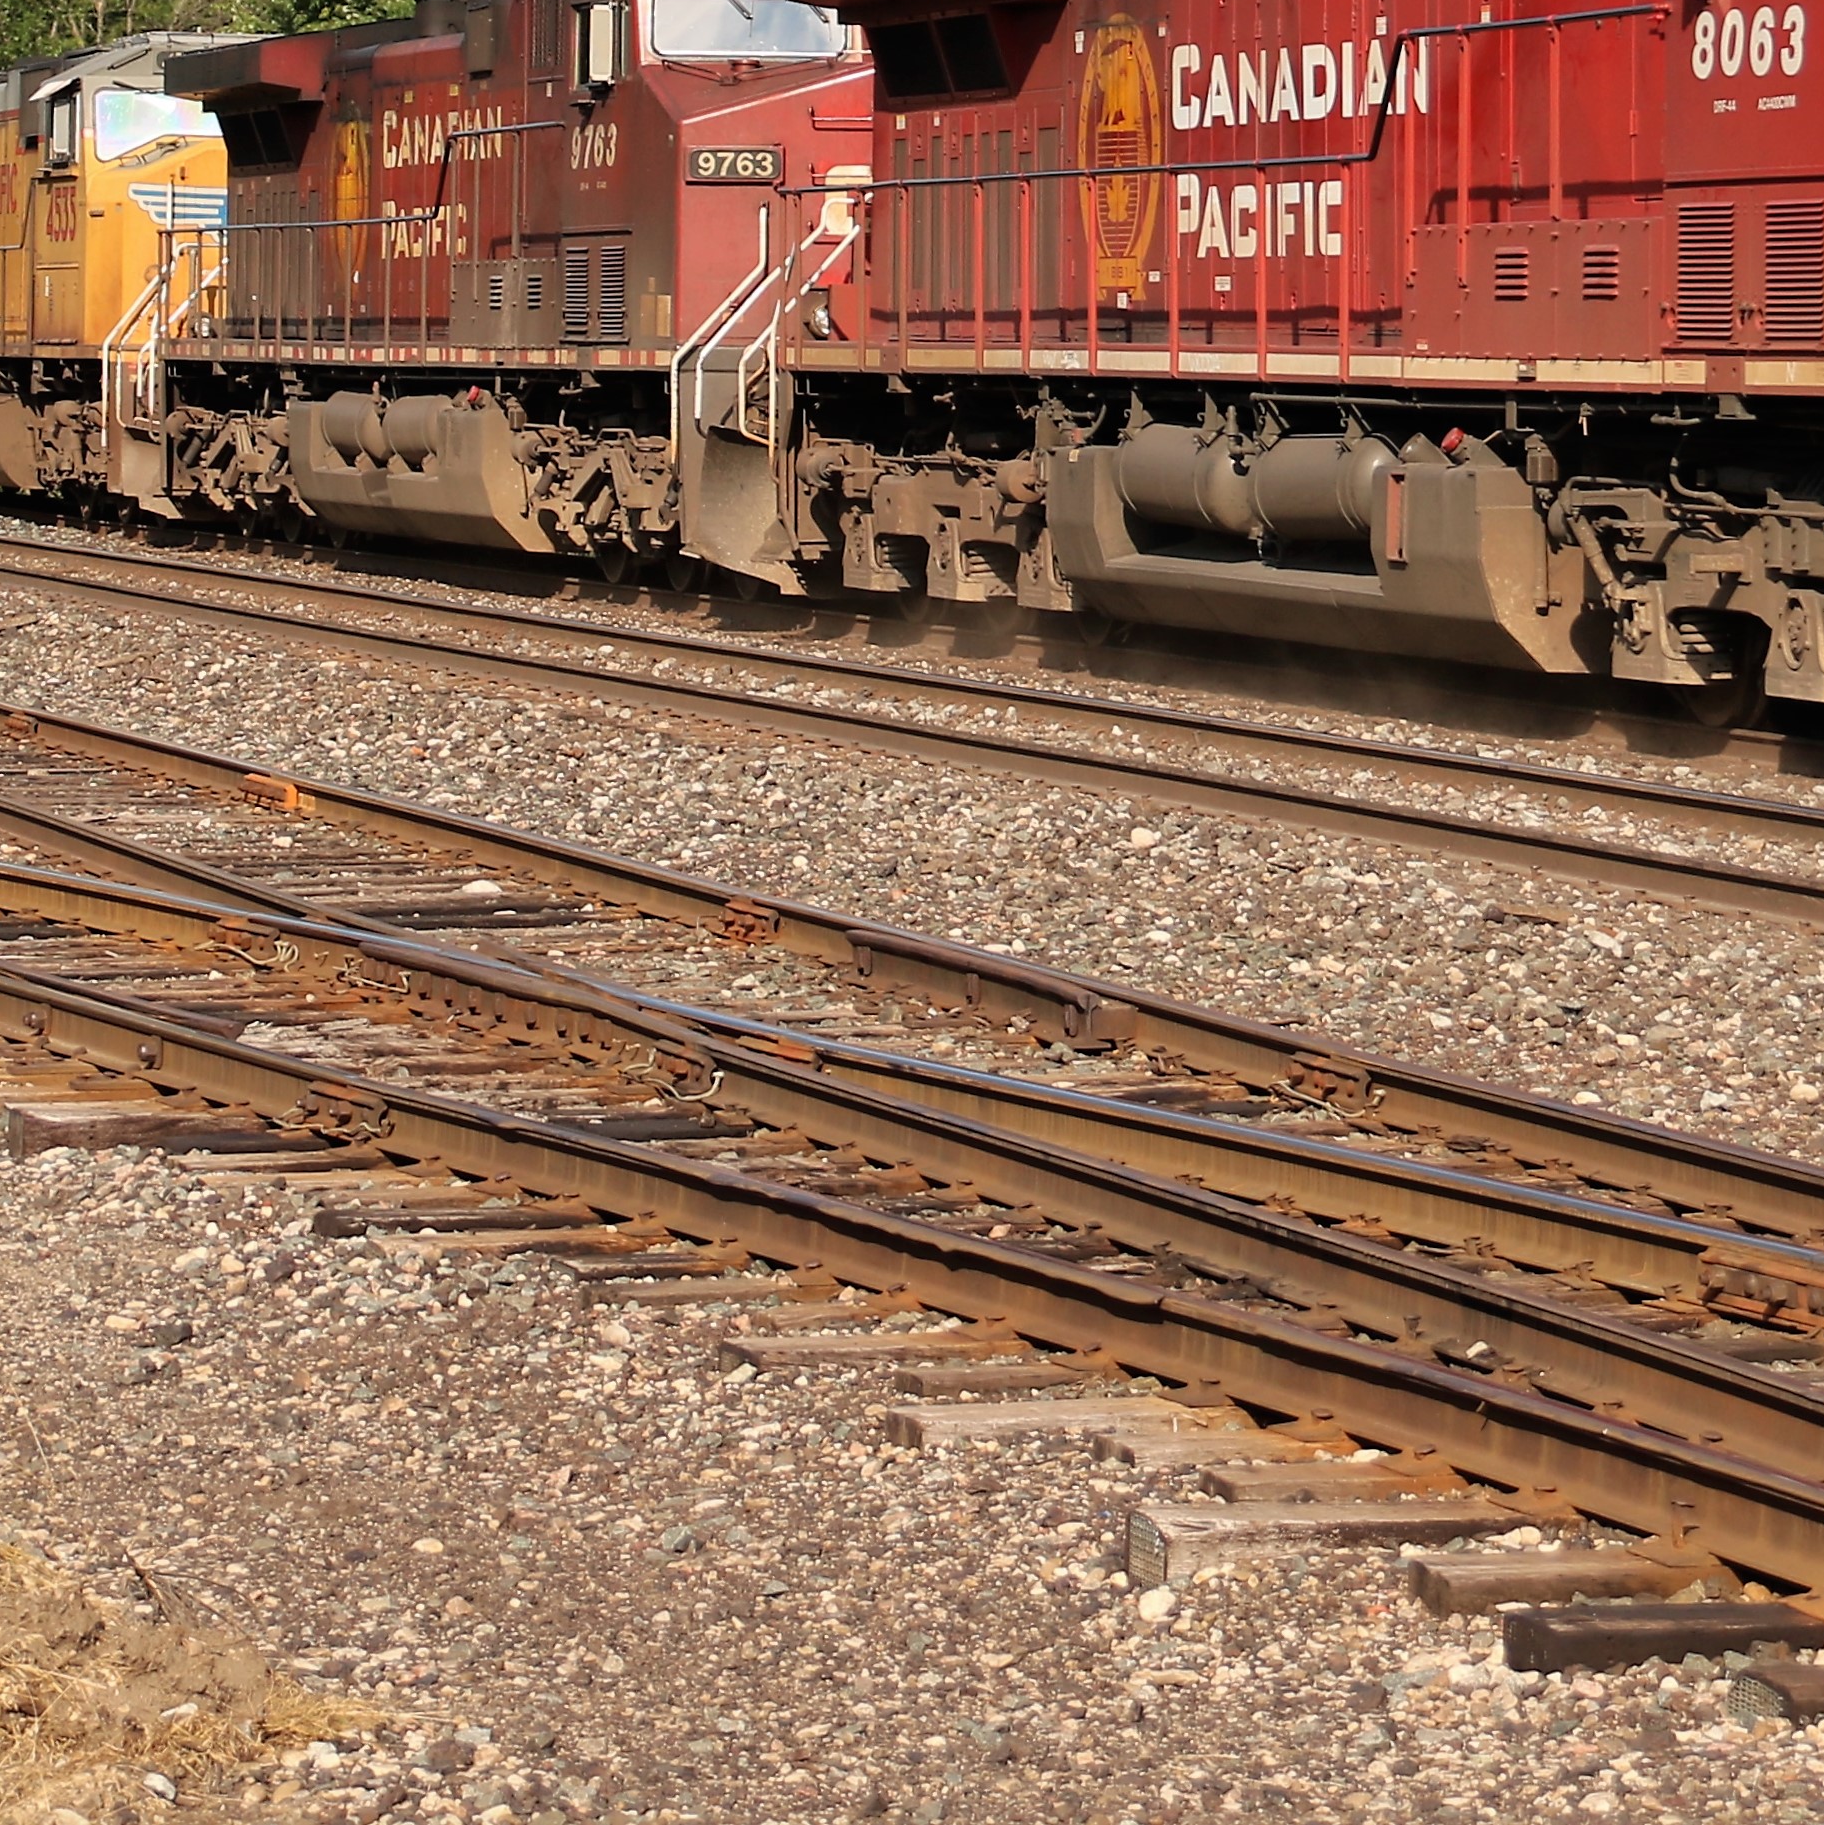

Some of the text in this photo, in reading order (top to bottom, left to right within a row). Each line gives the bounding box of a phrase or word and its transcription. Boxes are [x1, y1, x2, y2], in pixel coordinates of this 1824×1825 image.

[1692, 4, 1805, 80] 8063
[1172, 36, 1429, 130] CANADIAN
[383, 106, 502, 169] CANADIAN
[571, 123, 617, 169] 9763
[698, 152, 774, 177] 9763
[47, 186, 77, 242] 4535
[381, 200, 467, 259] PACIFIC
[1177, 173, 1343, 259] PACIFIC
